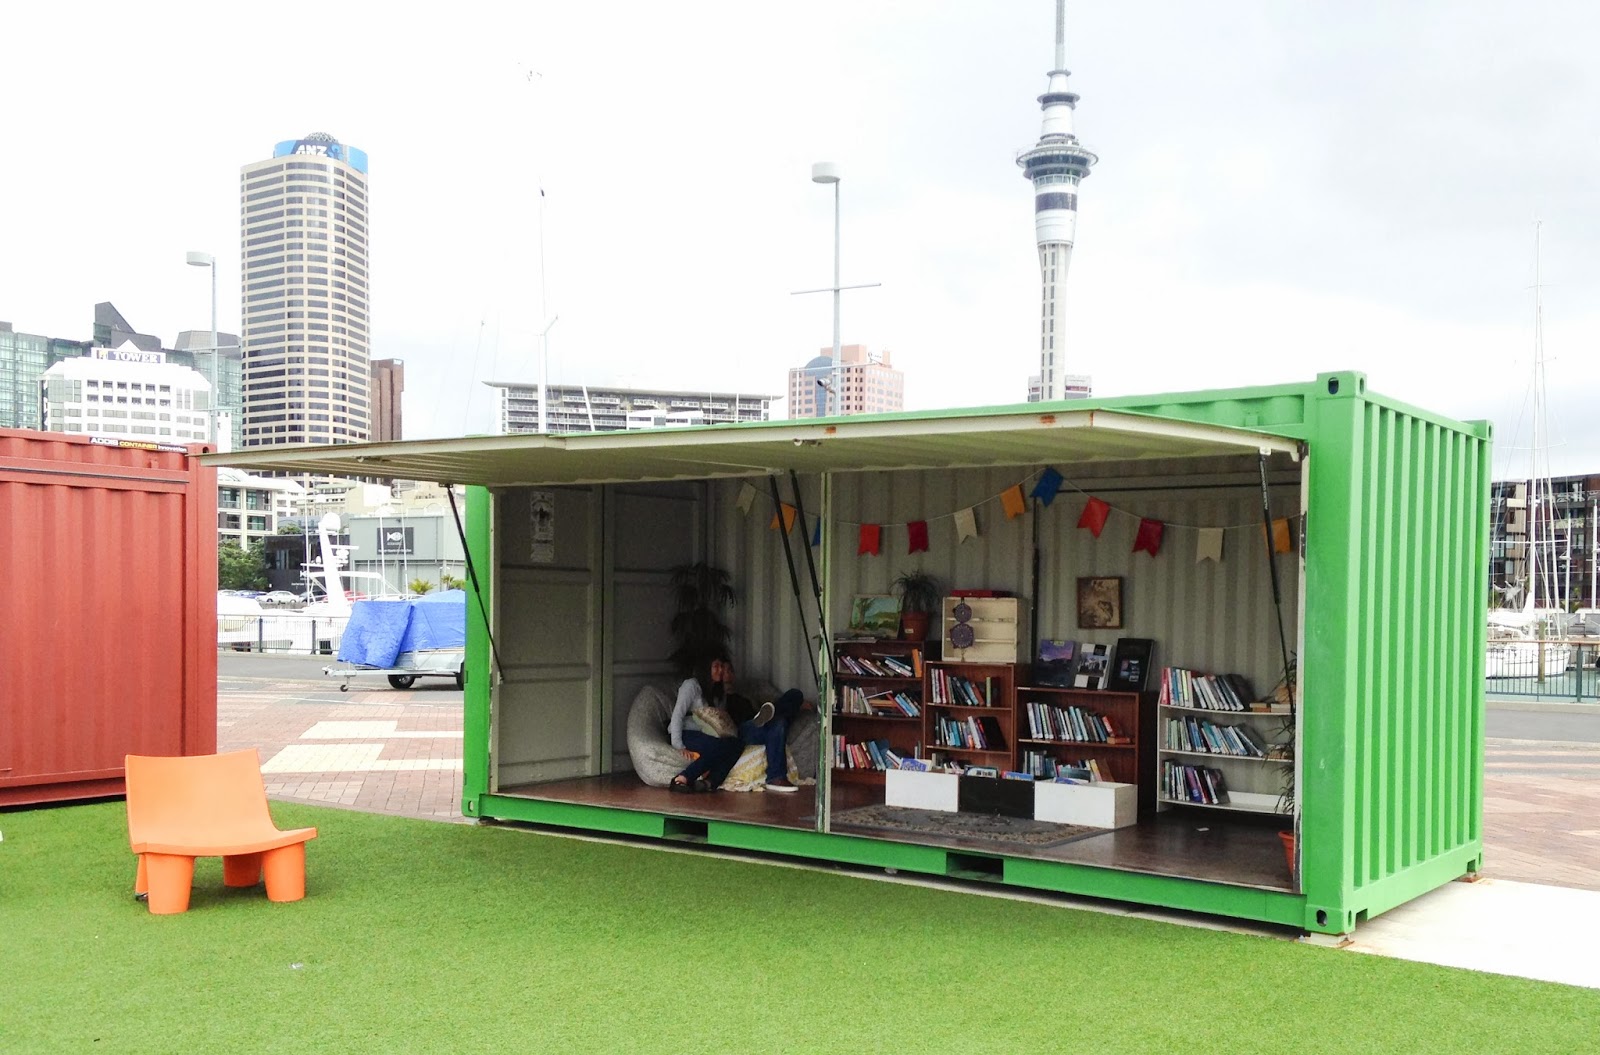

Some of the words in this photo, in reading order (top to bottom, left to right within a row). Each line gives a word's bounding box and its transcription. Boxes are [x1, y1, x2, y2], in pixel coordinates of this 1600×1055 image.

[295, 144, 328, 157] ANZ
[113, 351, 158, 363] TOWER
[119, 441, 157, 449] CONTAINER
